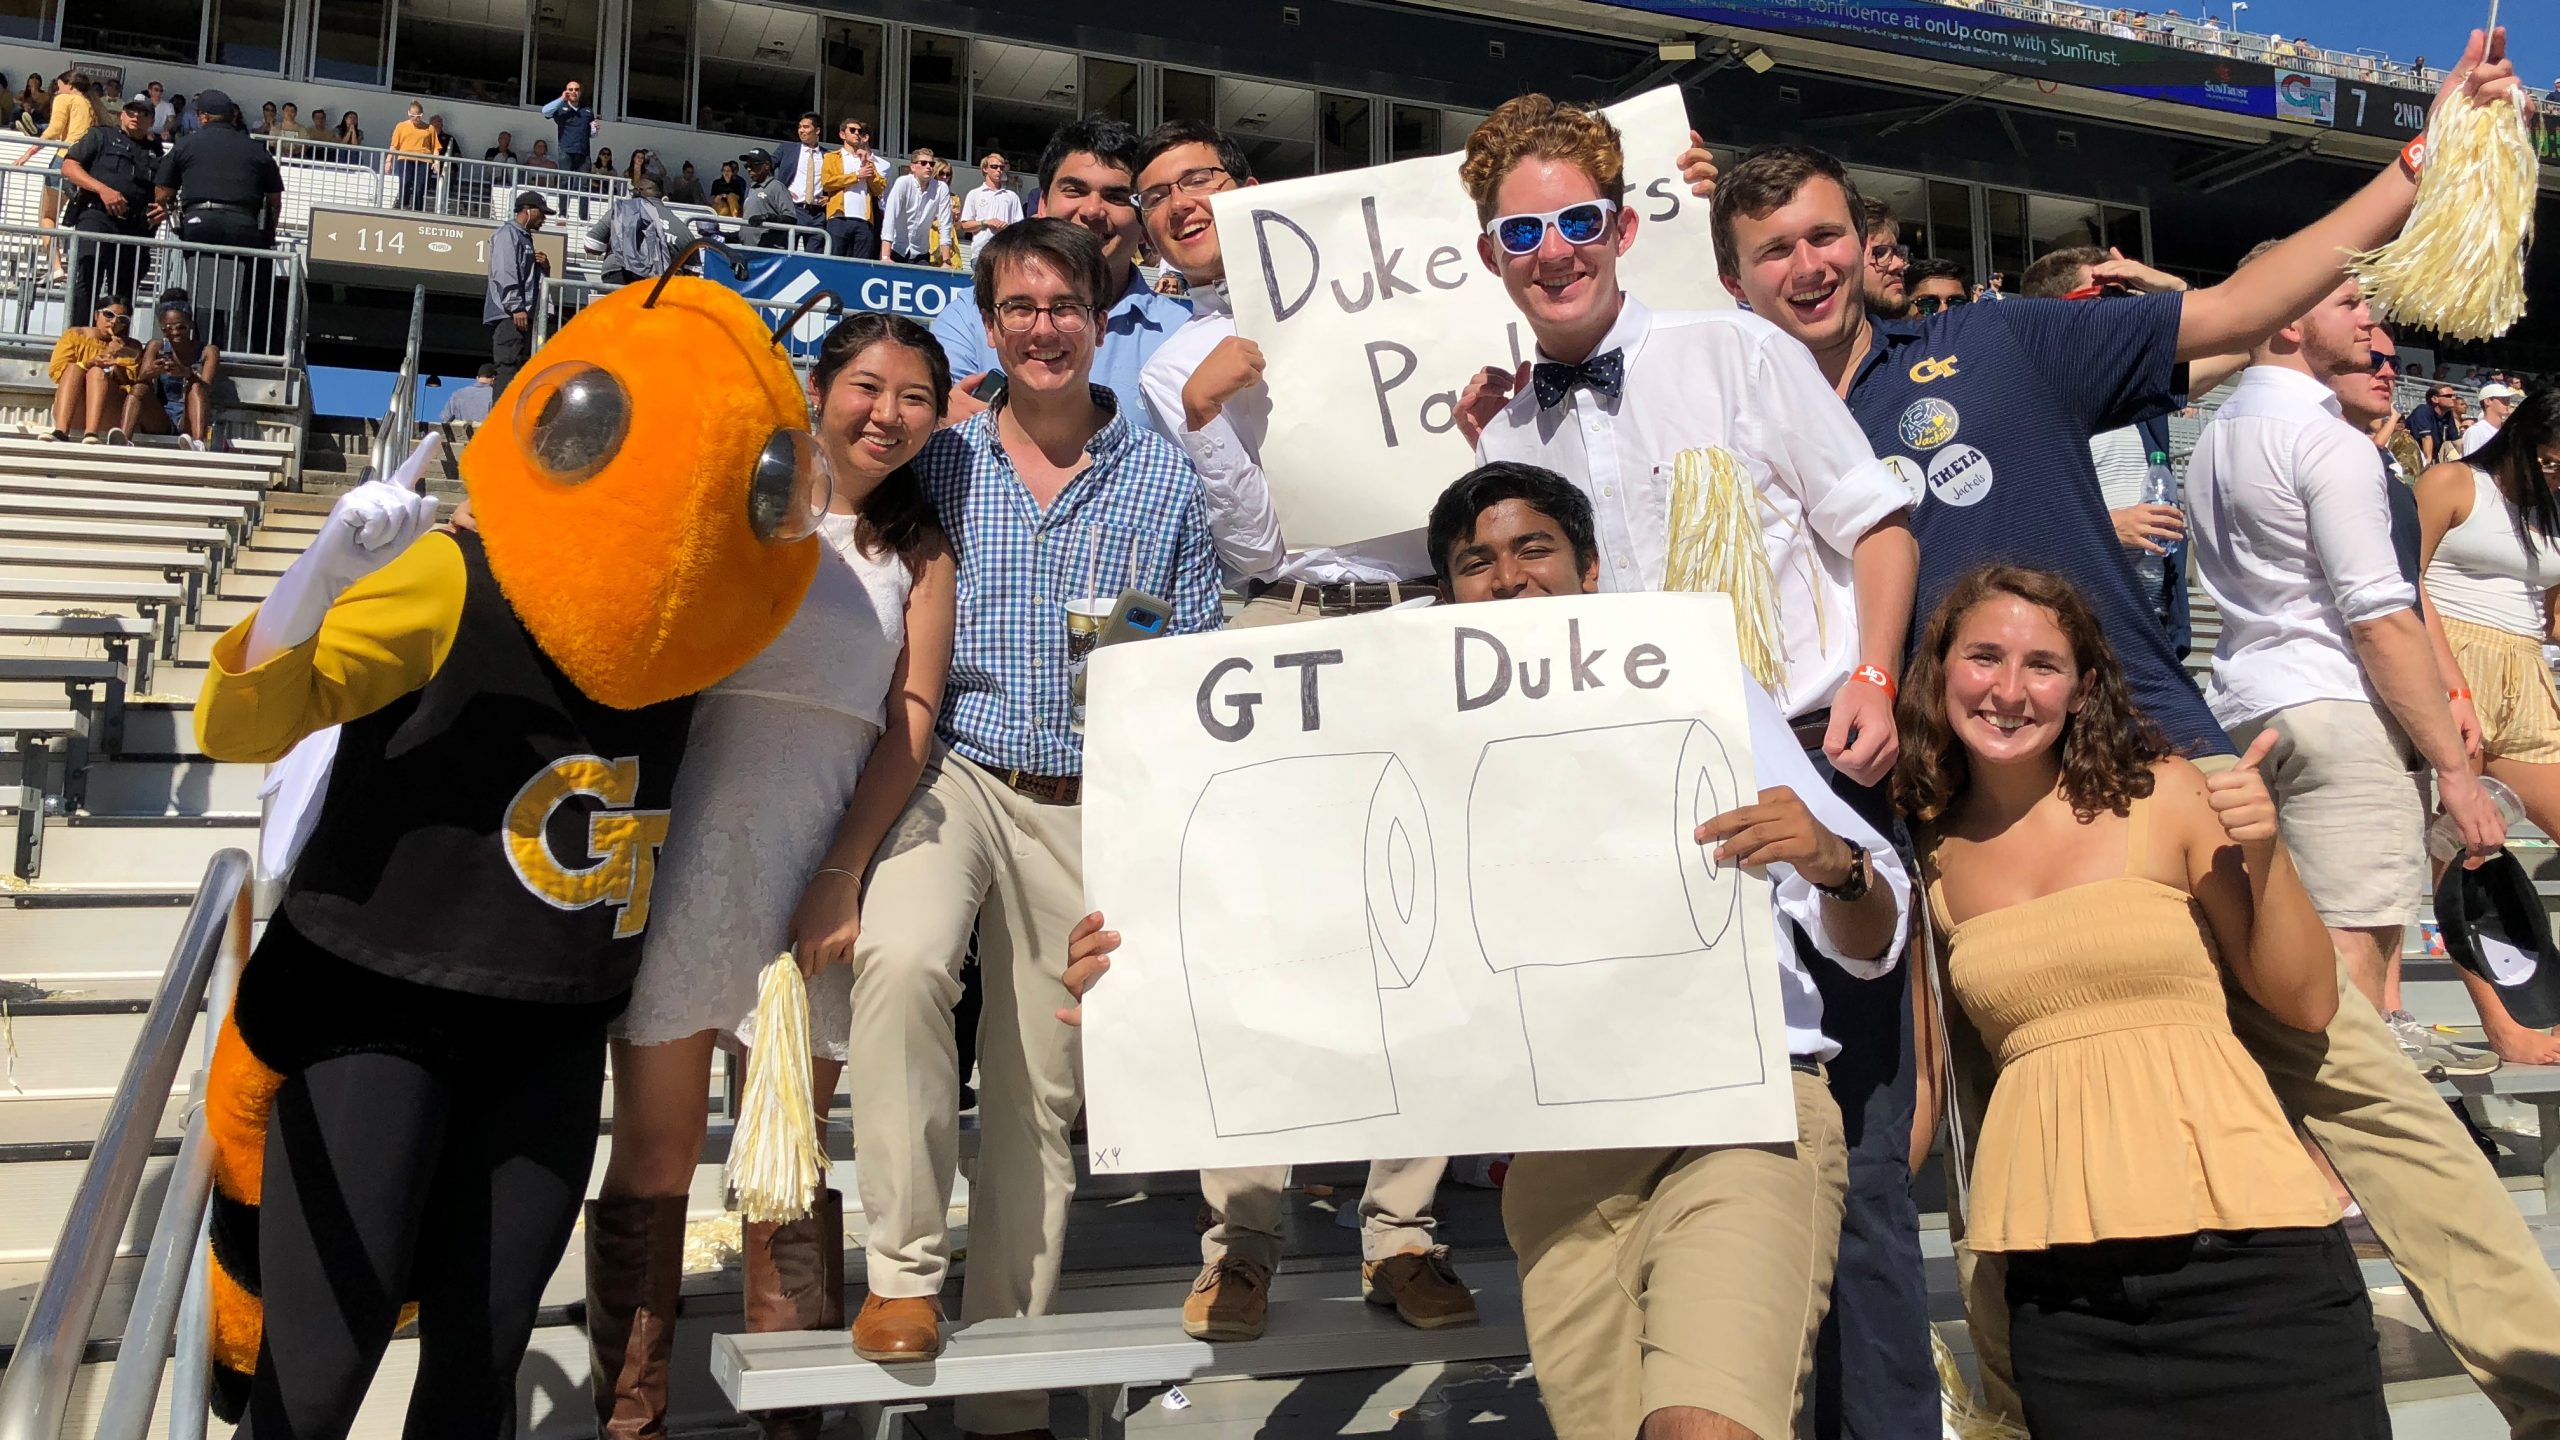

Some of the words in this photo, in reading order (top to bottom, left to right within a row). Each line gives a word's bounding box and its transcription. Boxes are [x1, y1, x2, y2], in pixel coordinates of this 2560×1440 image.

[1808, 0, 1899, 26] confidence
[1904, 14, 1920, 30] at
[1925, 19, 2008, 47] onUp.com
[2012, 34, 2046, 53] with
[2050, 38, 2121, 67] SunTrust.
[2281, 74, 2330, 117] GT
[2351, 88, 2367, 127] 7
[2393, 102, 2424, 130] 2ND
[357, 228, 405, 254] 114
[418, 226, 464, 239] SECTION
[1251, 196, 1468, 323] Duke
[1909, 355, 1958, 383] GT
[1930, 450, 1982, 488] THETA
[1196, 649, 1343, 742] GT
[1454, 618, 1670, 712] Duke
[1859, 665, 1886, 687] GT
[502, 754, 672, 939] GT
